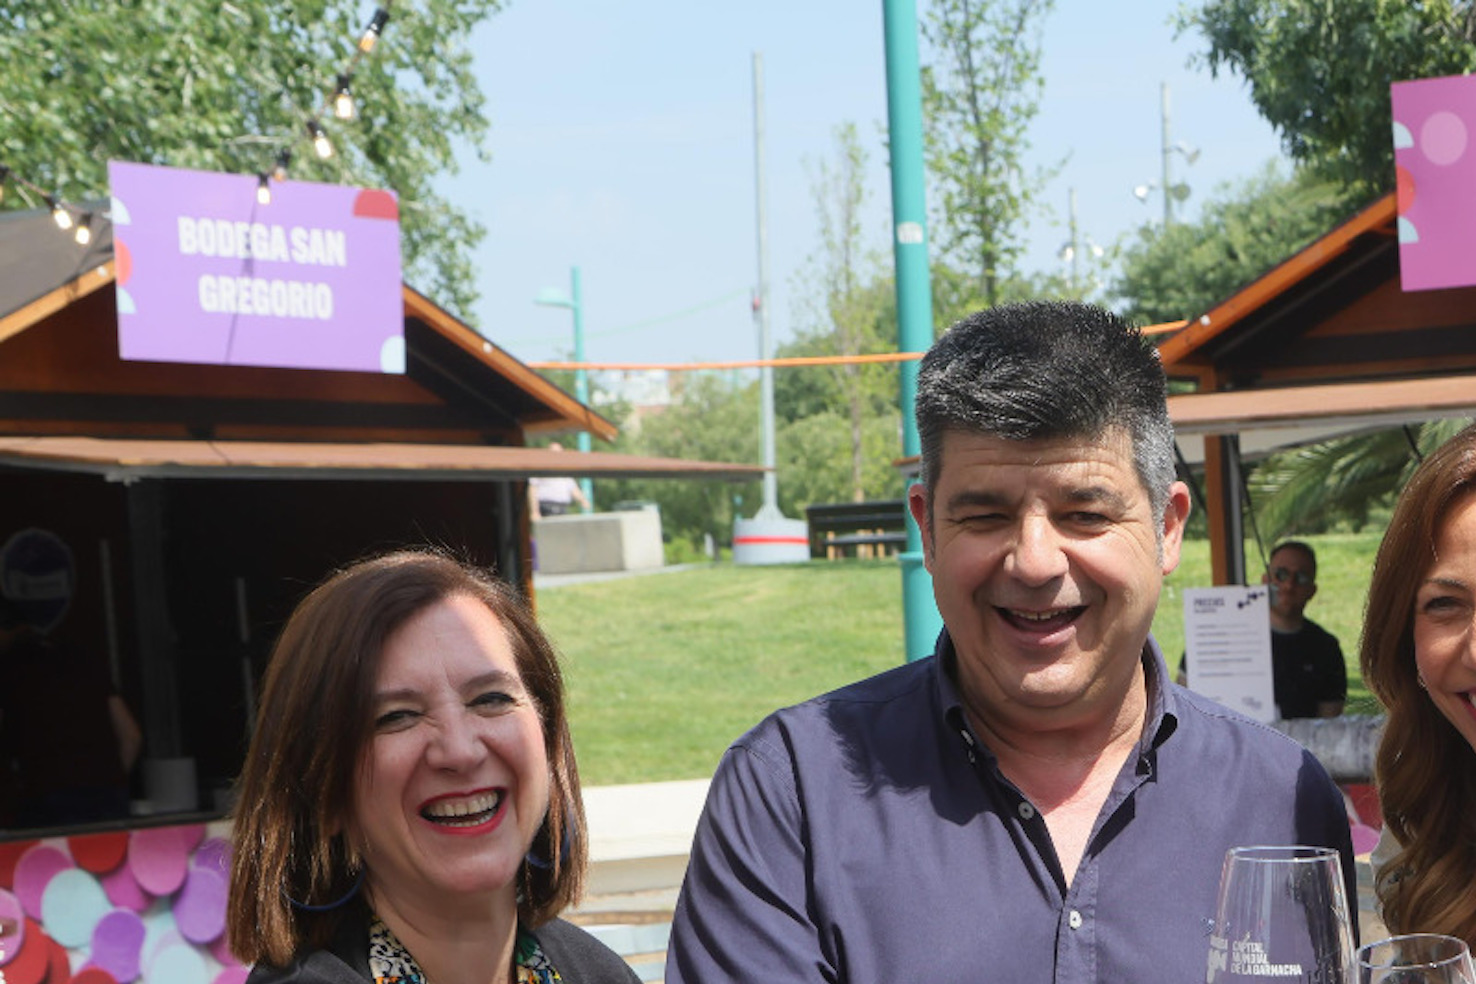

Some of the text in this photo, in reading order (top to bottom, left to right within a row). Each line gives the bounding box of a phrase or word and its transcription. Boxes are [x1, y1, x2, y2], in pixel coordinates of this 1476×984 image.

[177, 215, 347, 267] BODEGA SAN
[198, 274, 334, 320] GREGORIO
